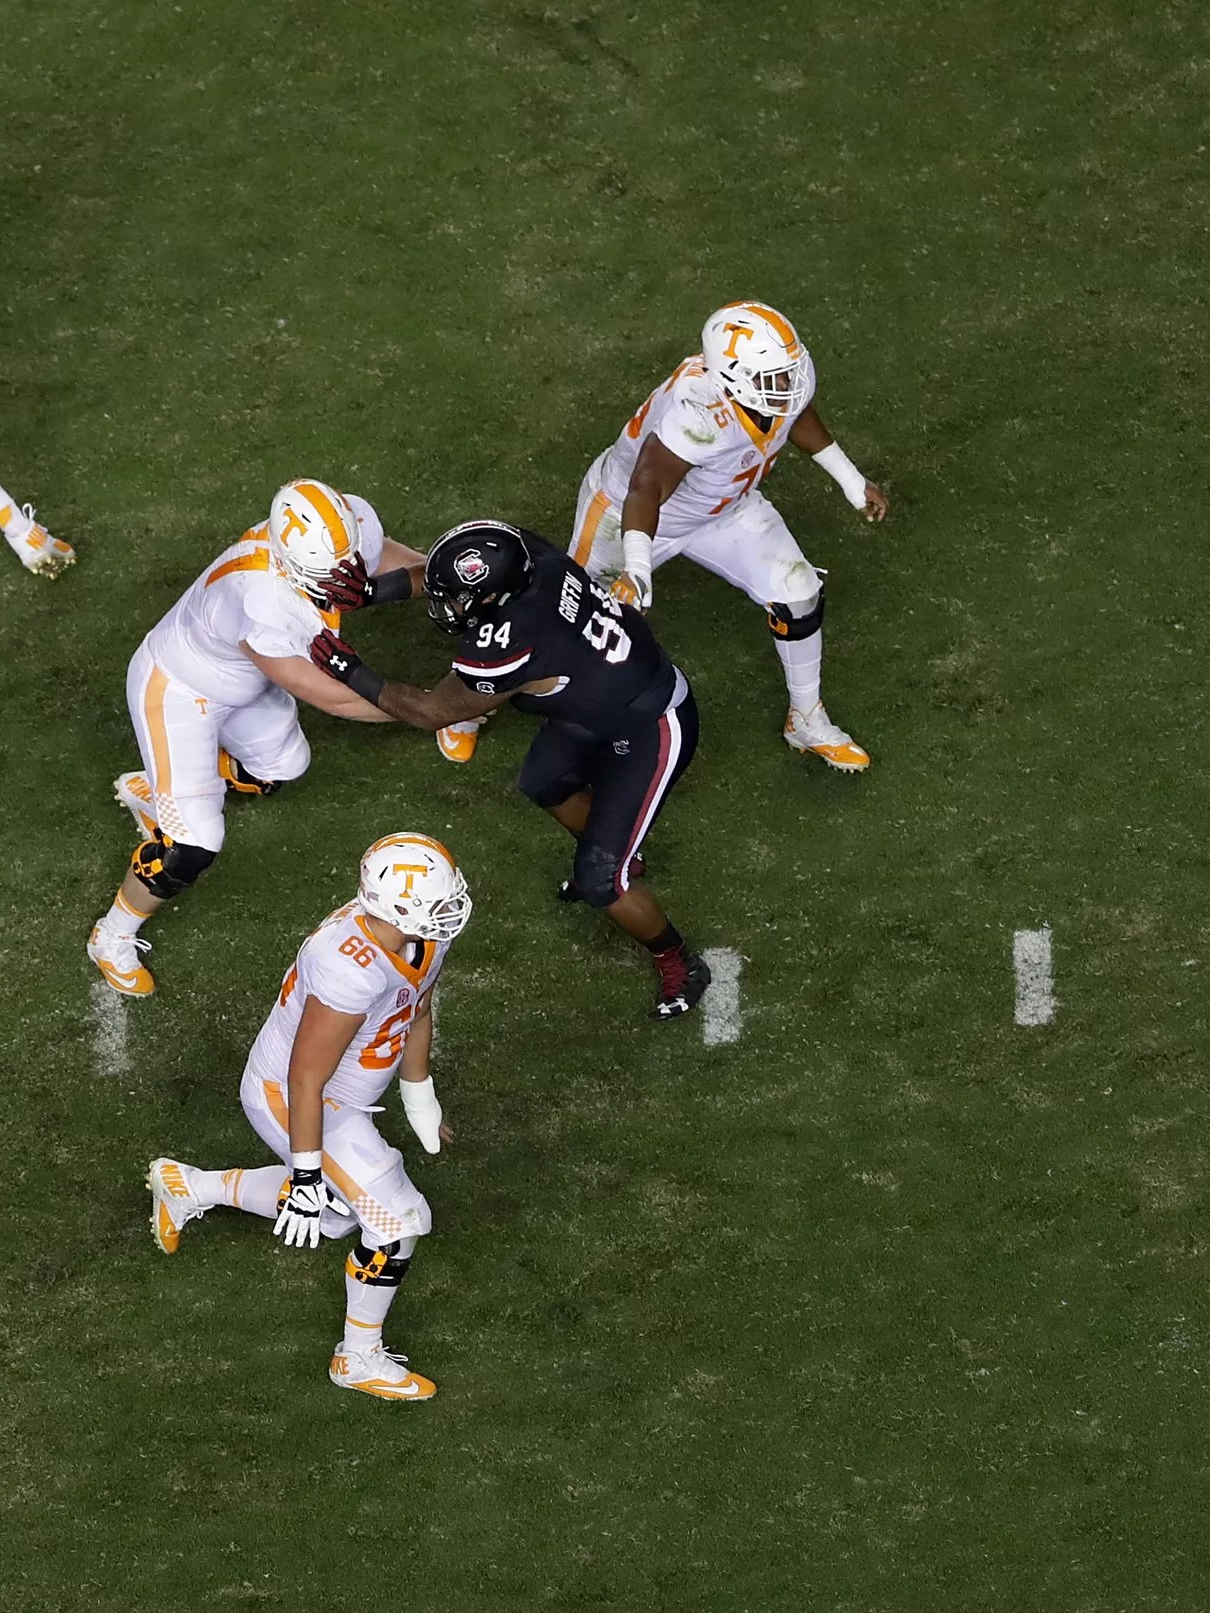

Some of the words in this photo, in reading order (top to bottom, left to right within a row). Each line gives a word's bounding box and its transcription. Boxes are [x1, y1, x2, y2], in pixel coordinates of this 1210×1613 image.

[722, 322, 754, 359] T
[280, 507, 308, 547] T
[558, 571, 583, 624] GRIFFIN
[476, 621, 511, 649] 94
[195, 698, 208, 715] T
[392, 863, 428, 899] T
[338, 935, 378, 968] 66
[357, 1004, 418, 1070] 6
[159, 1163, 191, 1198] NIKE
